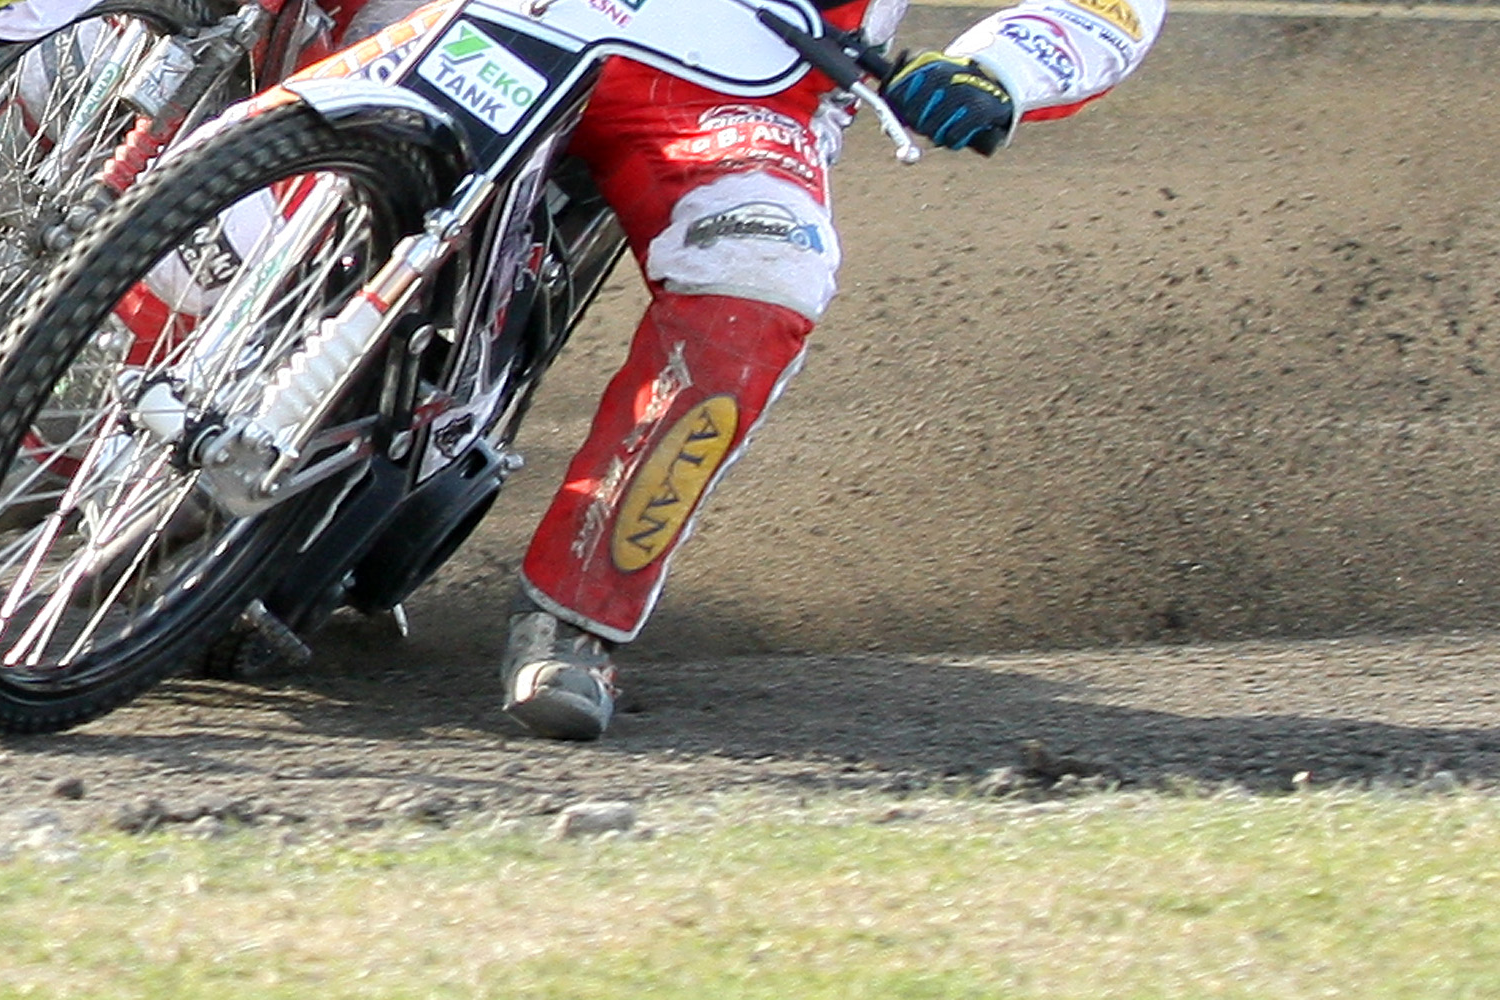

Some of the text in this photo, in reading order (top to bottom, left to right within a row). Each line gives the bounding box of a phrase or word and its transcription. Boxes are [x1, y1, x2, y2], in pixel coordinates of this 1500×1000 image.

[433, 60, 507, 123] TANK
[476, 60, 534, 108] EKO
[626, 405, 721, 554] ALAN
